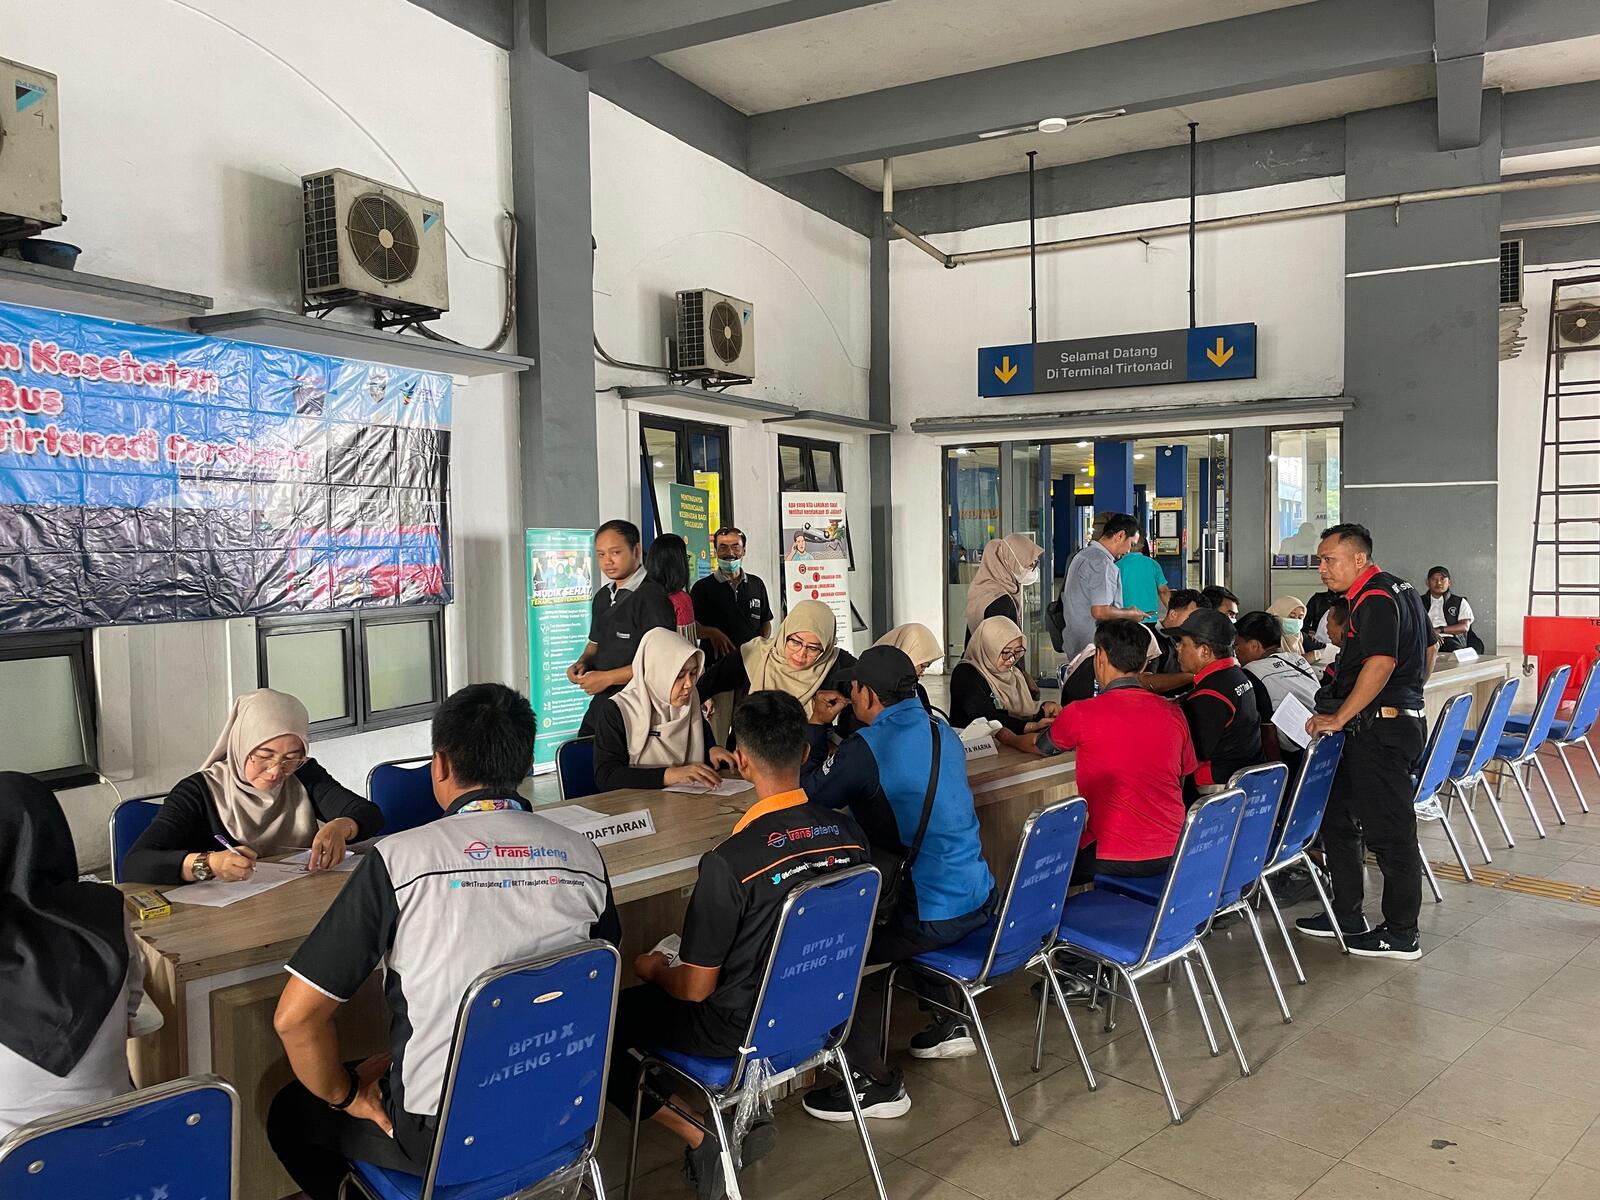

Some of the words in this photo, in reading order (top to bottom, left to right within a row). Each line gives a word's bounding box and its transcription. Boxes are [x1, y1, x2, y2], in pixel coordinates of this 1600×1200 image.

[1060, 350, 1109, 363] Selamat
[1113, 346, 1158, 359] Datang
[1046, 368, 1059, 379] Di
[1063, 362, 1113, 378] Terminal
[1116, 359, 1173, 374] Tirtonadi
[582, 819, 647, 840] DAFTARAN
[786, 824, 839, 841] transjateng
[494, 845, 568, 861] transjateng
[836, 932, 845, 945] X
[781, 955, 827, 979] JATENG
[836, 944, 857, 961] DIY
[560, 1022, 575, 1039] X
[478, 1052, 551, 1088] JATENG
[566, 1033, 597, 1057] DIY
